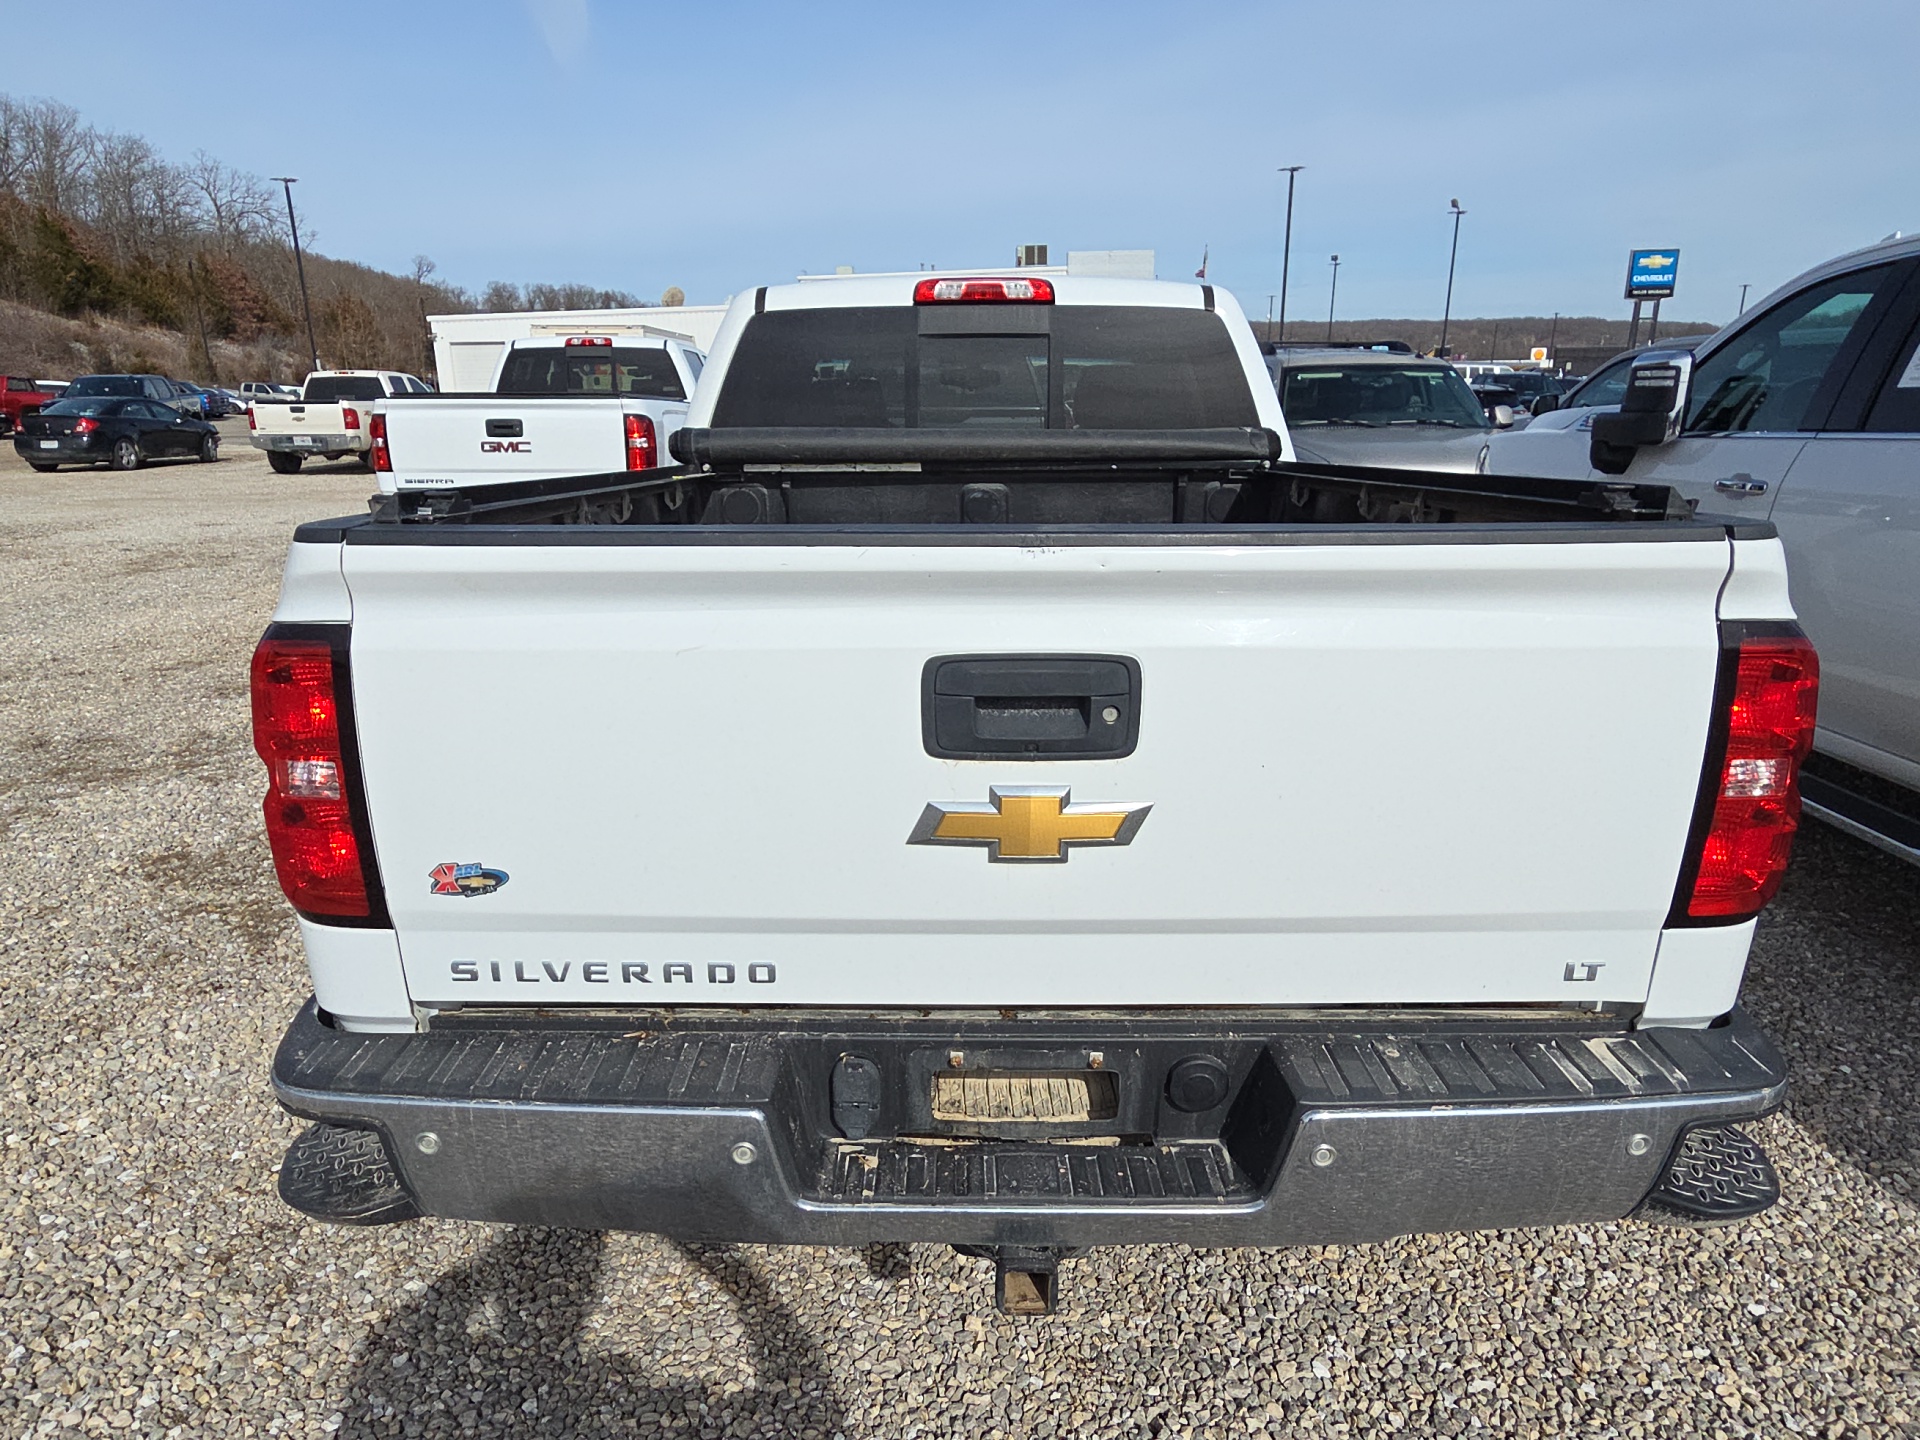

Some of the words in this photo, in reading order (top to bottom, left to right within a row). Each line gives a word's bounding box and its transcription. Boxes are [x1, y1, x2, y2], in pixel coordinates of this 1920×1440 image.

[1633, 274, 1673, 282] CHEVROLET
[481, 441, 532, 453] GMC
[450, 960, 777, 984] SILVERADO
[1563, 962, 1606, 981] LT
